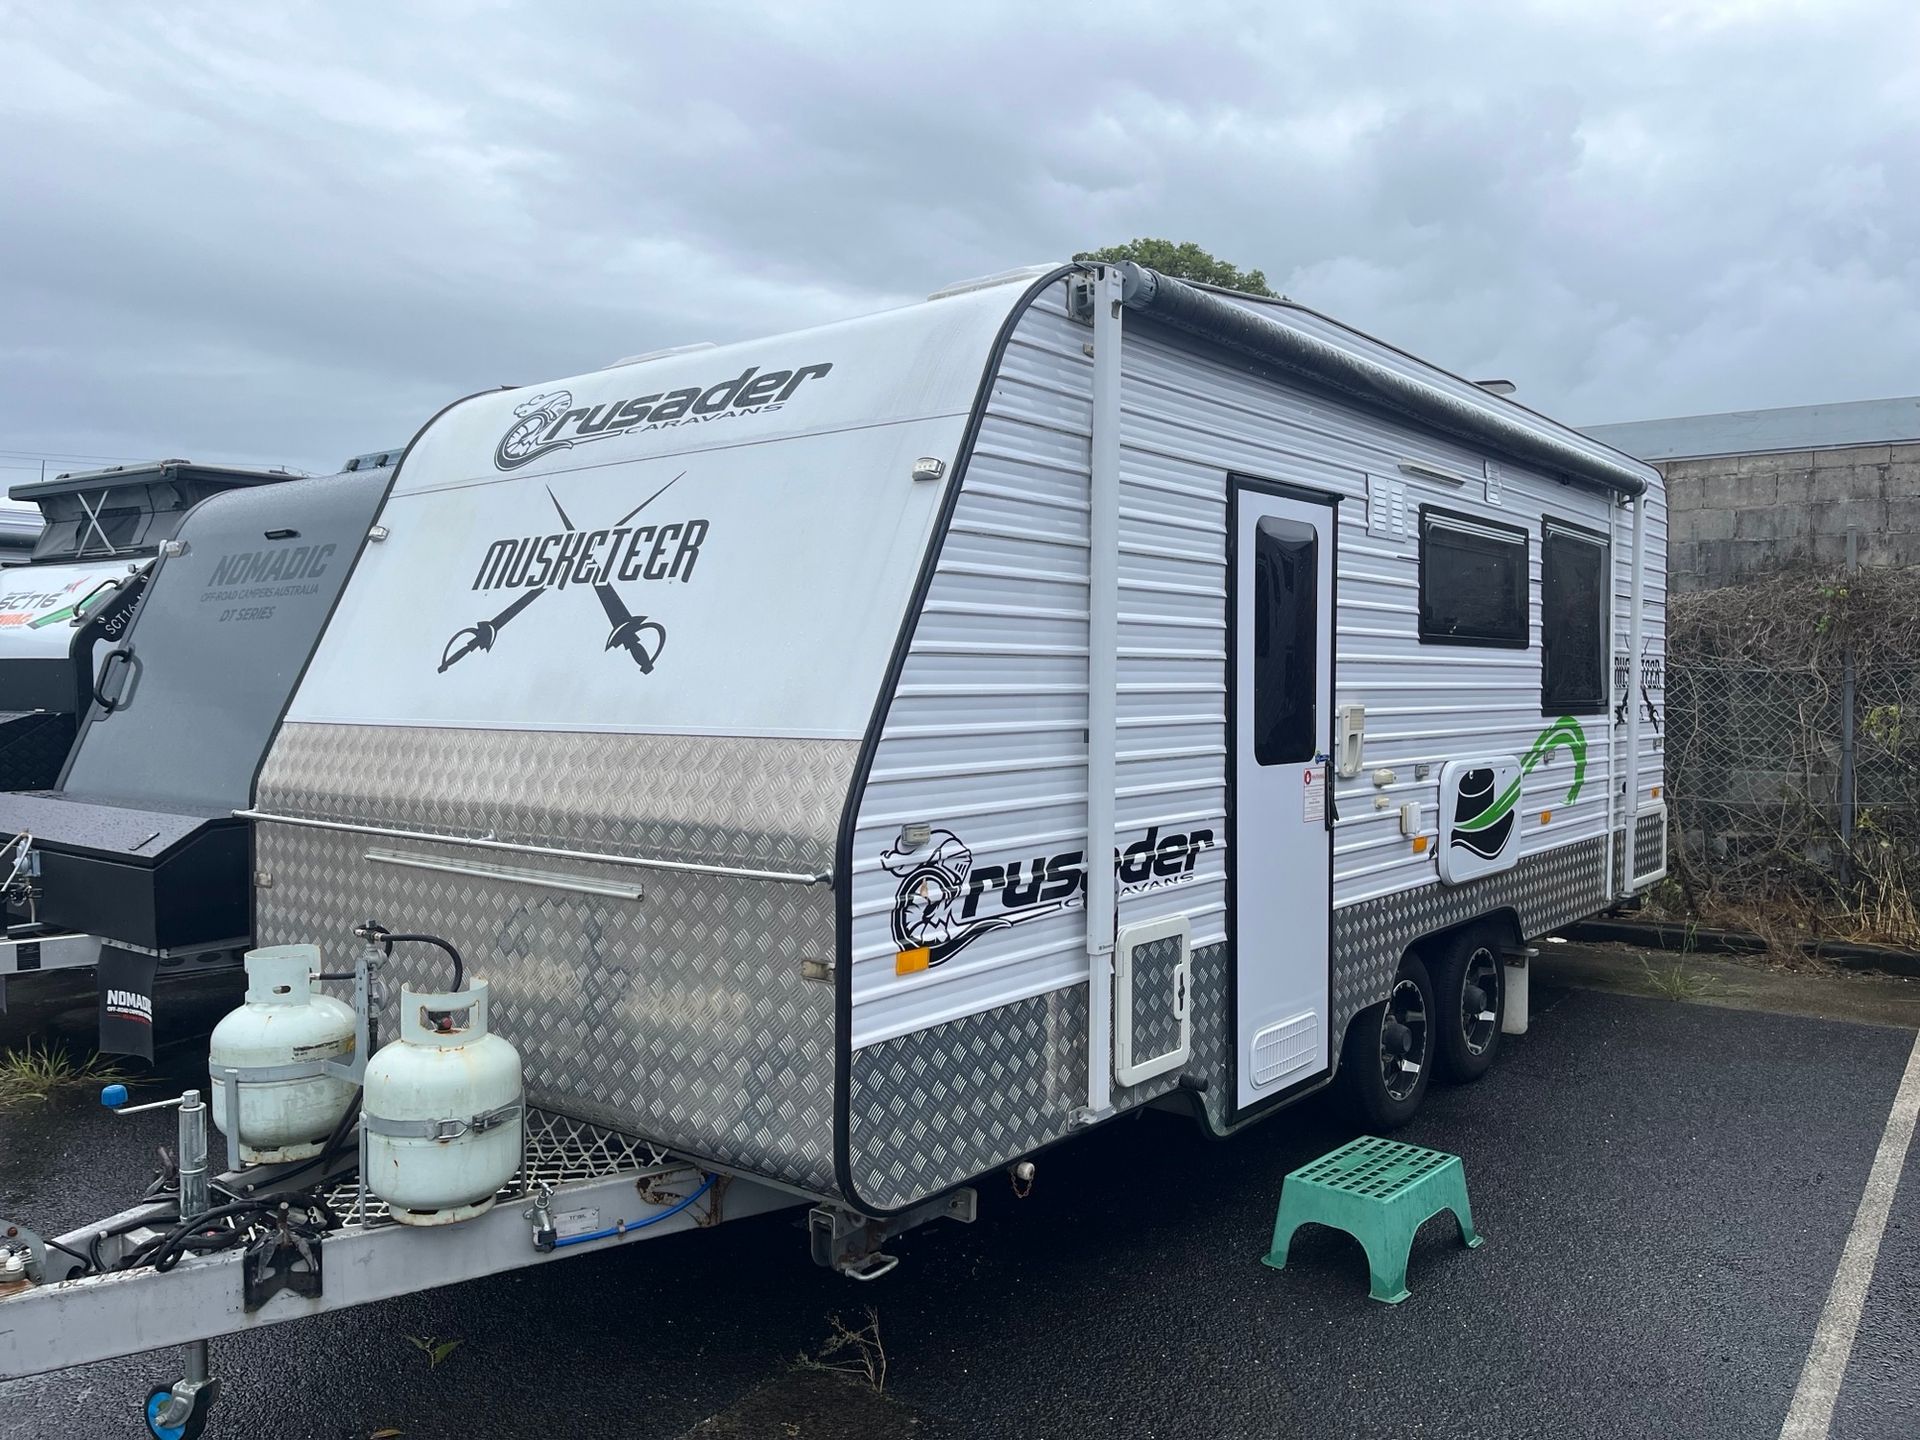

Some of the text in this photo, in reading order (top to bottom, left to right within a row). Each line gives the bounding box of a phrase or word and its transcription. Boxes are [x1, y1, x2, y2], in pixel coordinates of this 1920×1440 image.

[623, 402, 783, 436] CARAVANS
[207, 543, 337, 587] NOMADIC
[471, 518, 711, 593] MUSKETEER
[274, 583, 319, 597] AUSTRALIA
[219, 606, 277, 622] DT SERIES
[1061, 872, 1195, 907] CAVANS
